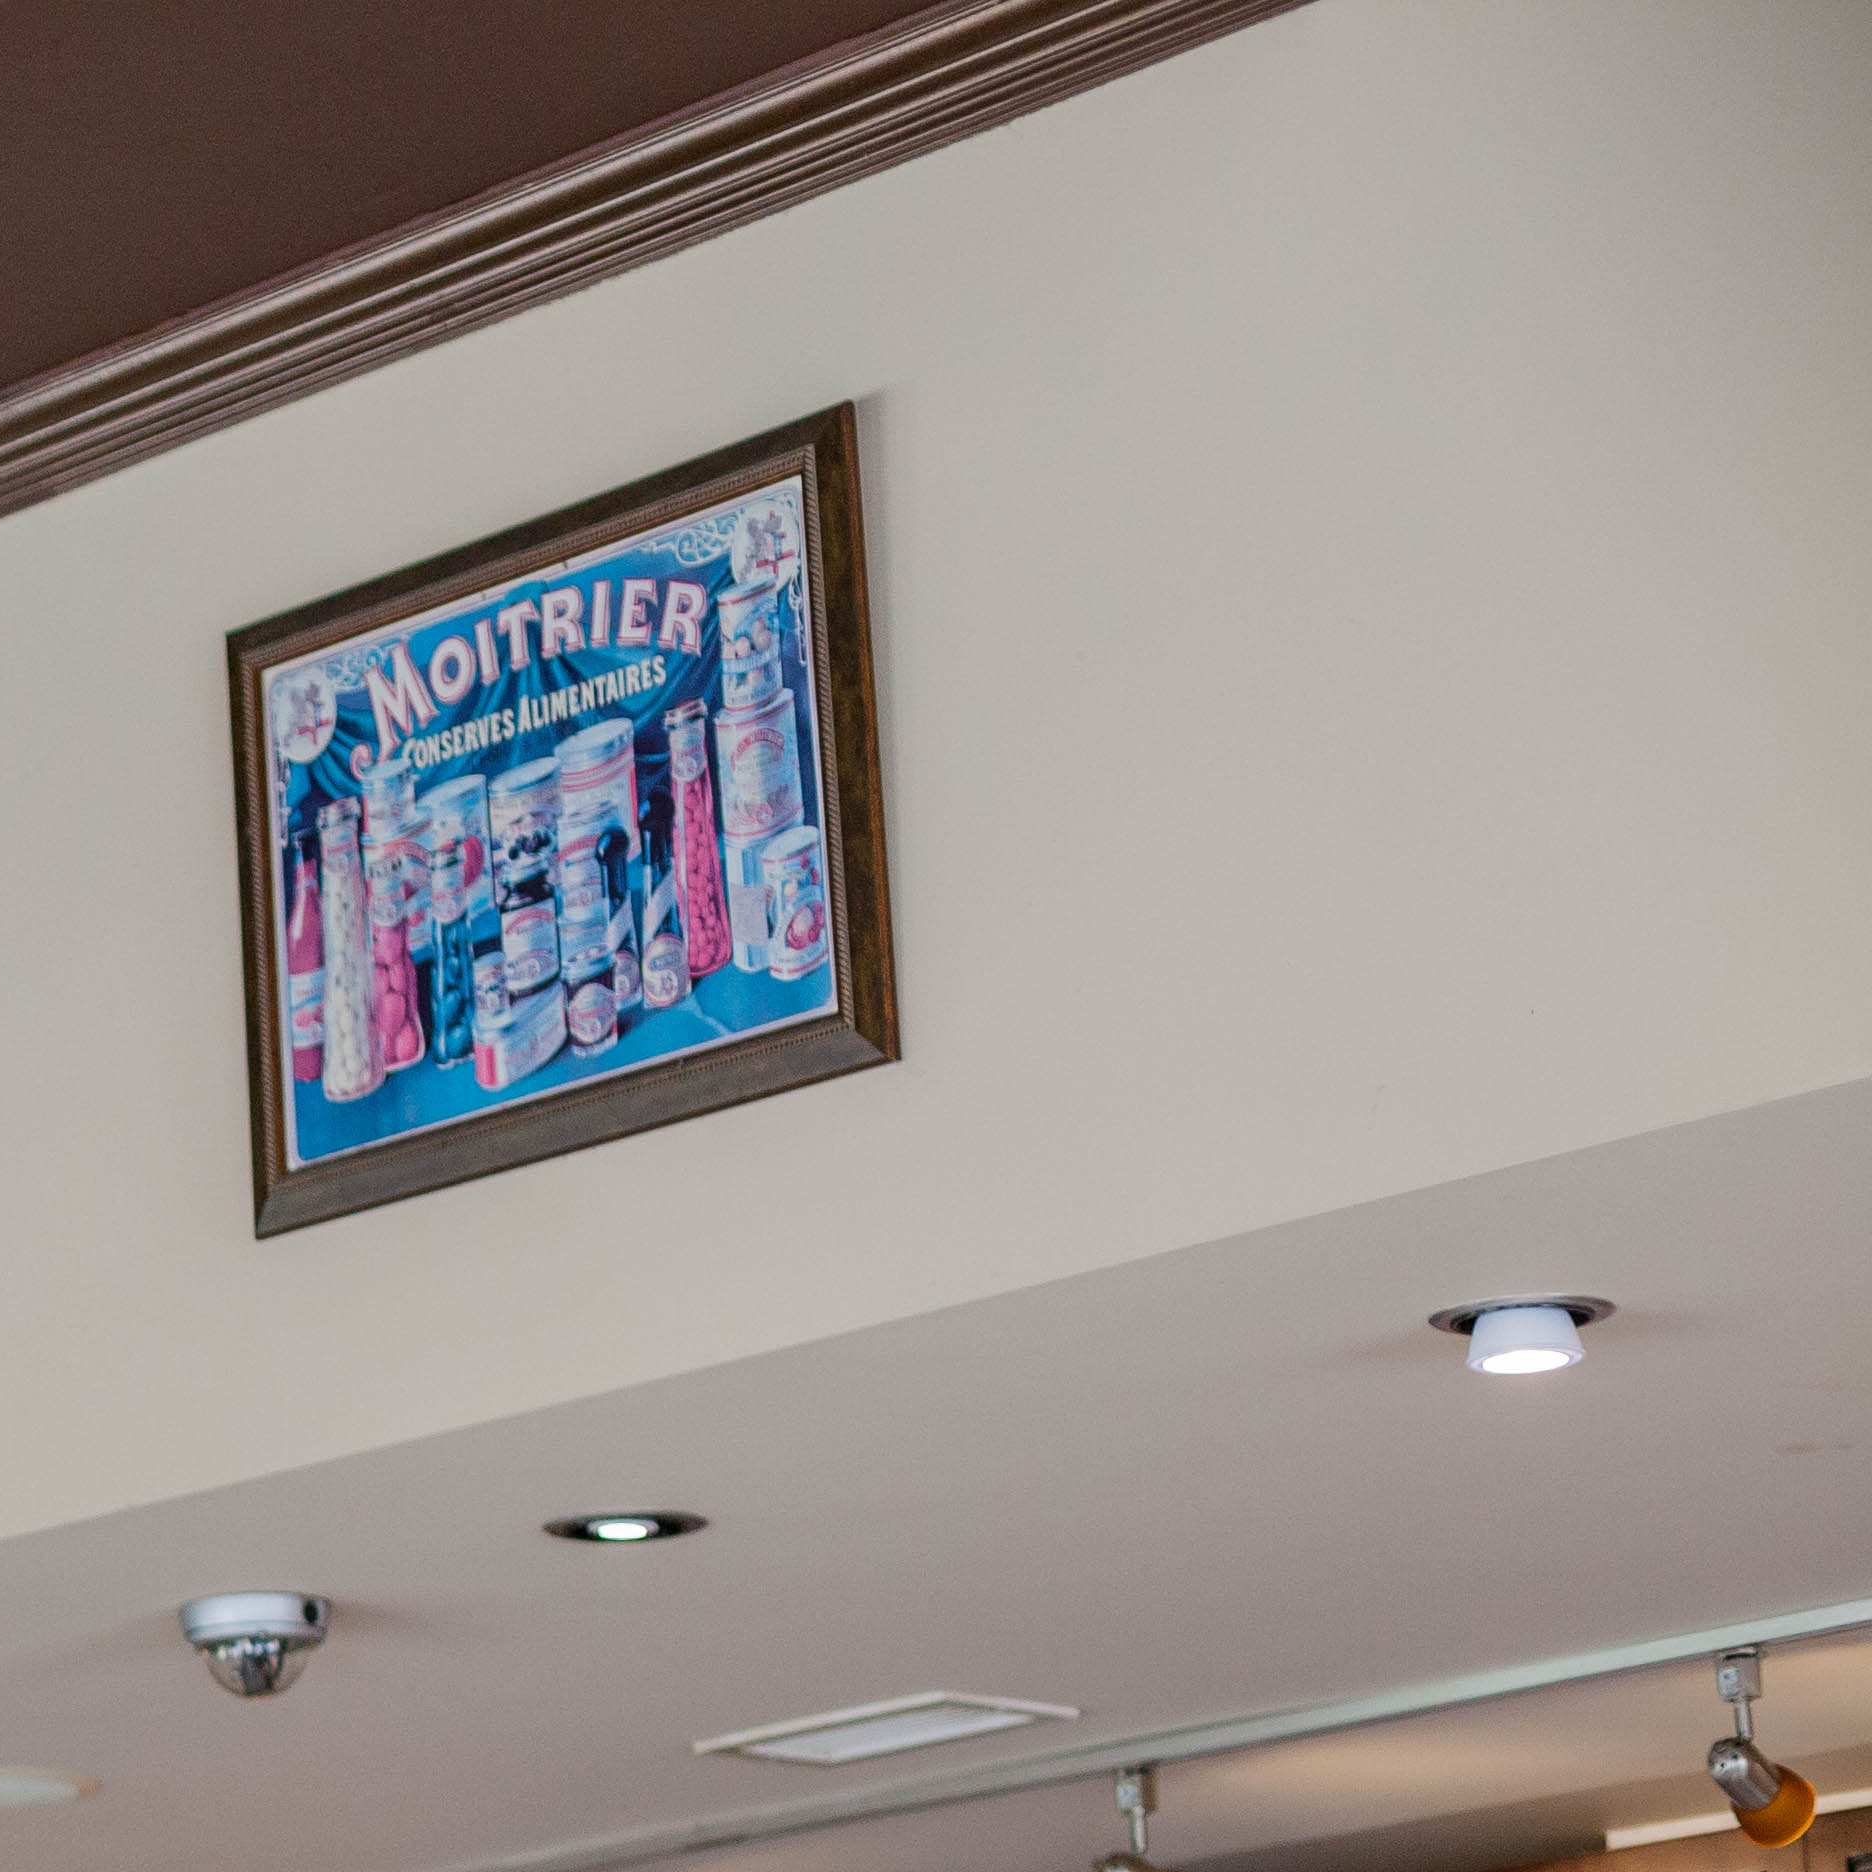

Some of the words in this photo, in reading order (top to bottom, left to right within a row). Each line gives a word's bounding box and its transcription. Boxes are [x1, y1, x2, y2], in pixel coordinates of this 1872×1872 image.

[350, 577, 708, 779] MOITRIER
[402, 708, 516, 770] CONSERVES
[516, 655, 667, 735] ALIMENTAIRES
